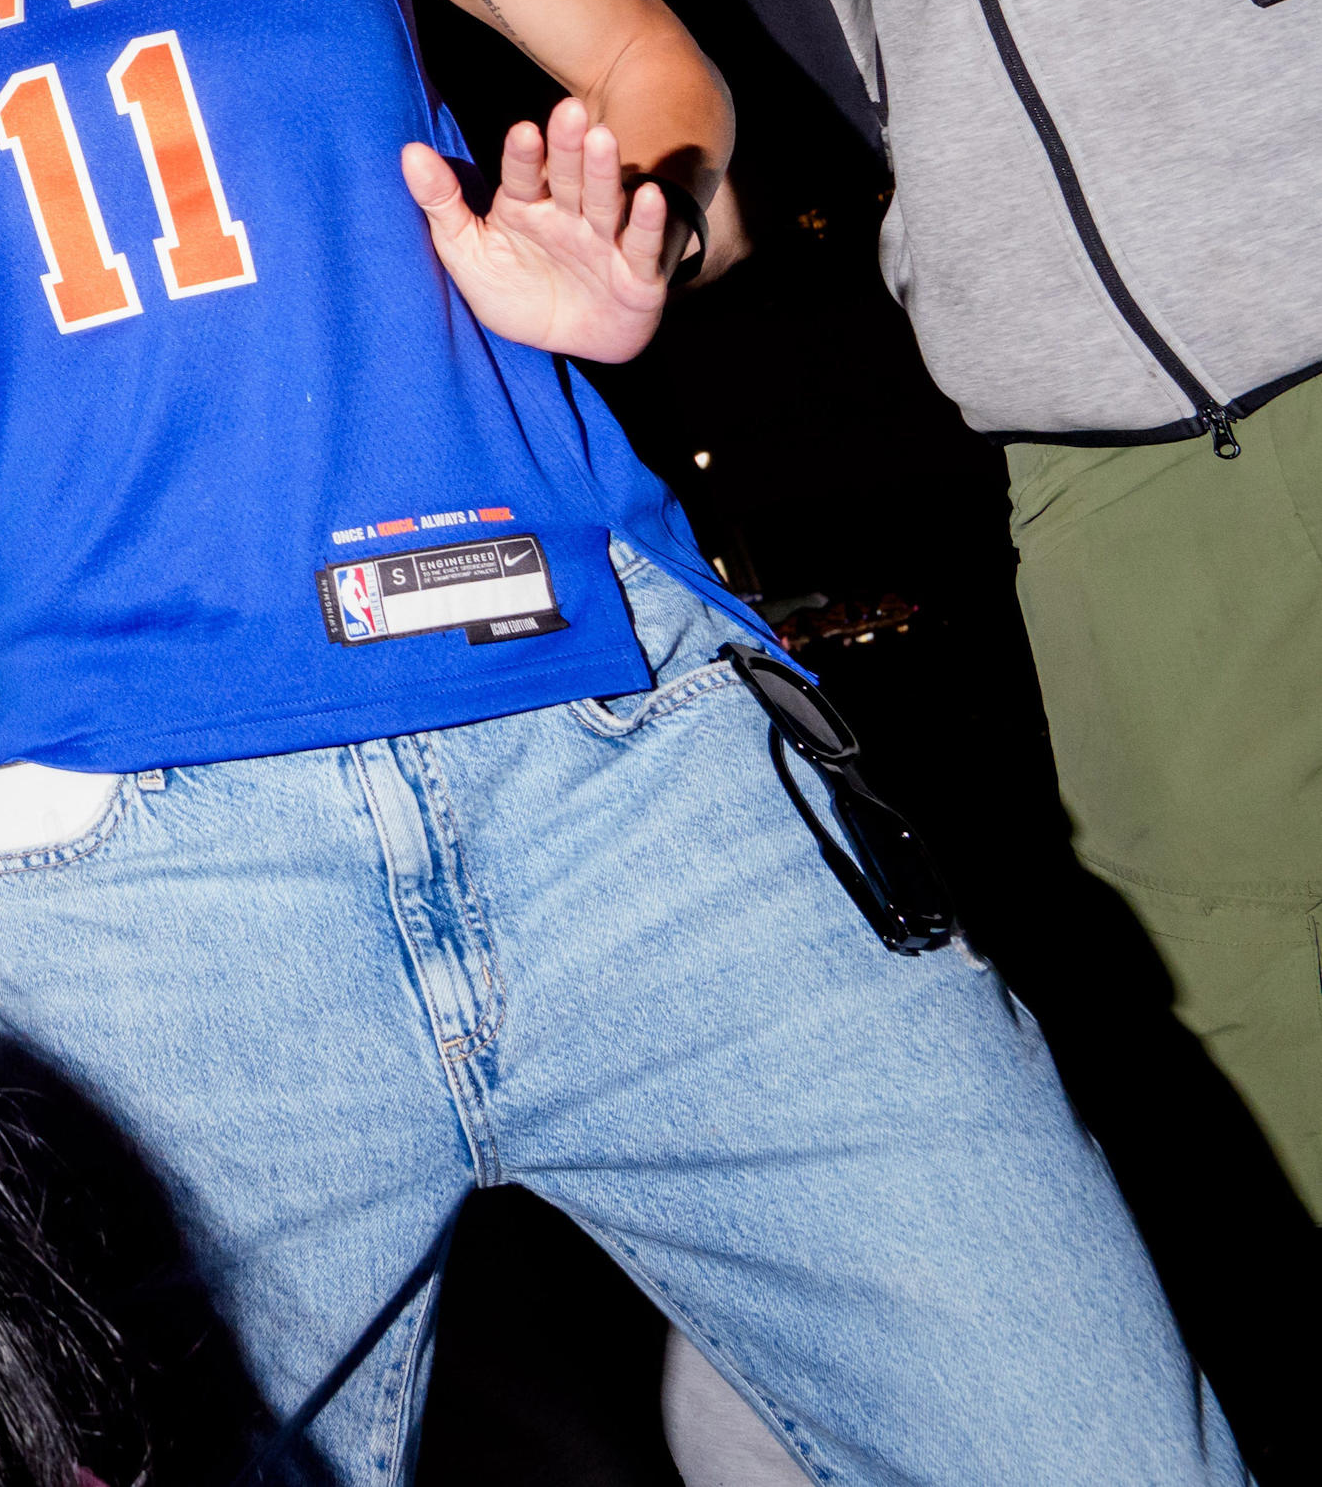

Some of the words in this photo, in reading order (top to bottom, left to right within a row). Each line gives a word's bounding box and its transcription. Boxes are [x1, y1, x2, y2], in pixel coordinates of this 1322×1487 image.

[331, 527, 365, 545] ONCE
[366, 525, 377, 539] A
[420, 511, 466, 529] ALWAYS
[468, 510, 478, 522] A
[419, 551, 496, 571] ENGINEERED
[391, 568, 406, 586] S
[320, 579, 339, 633] SWINGMAN
[508, 616, 539, 633] EDITION
